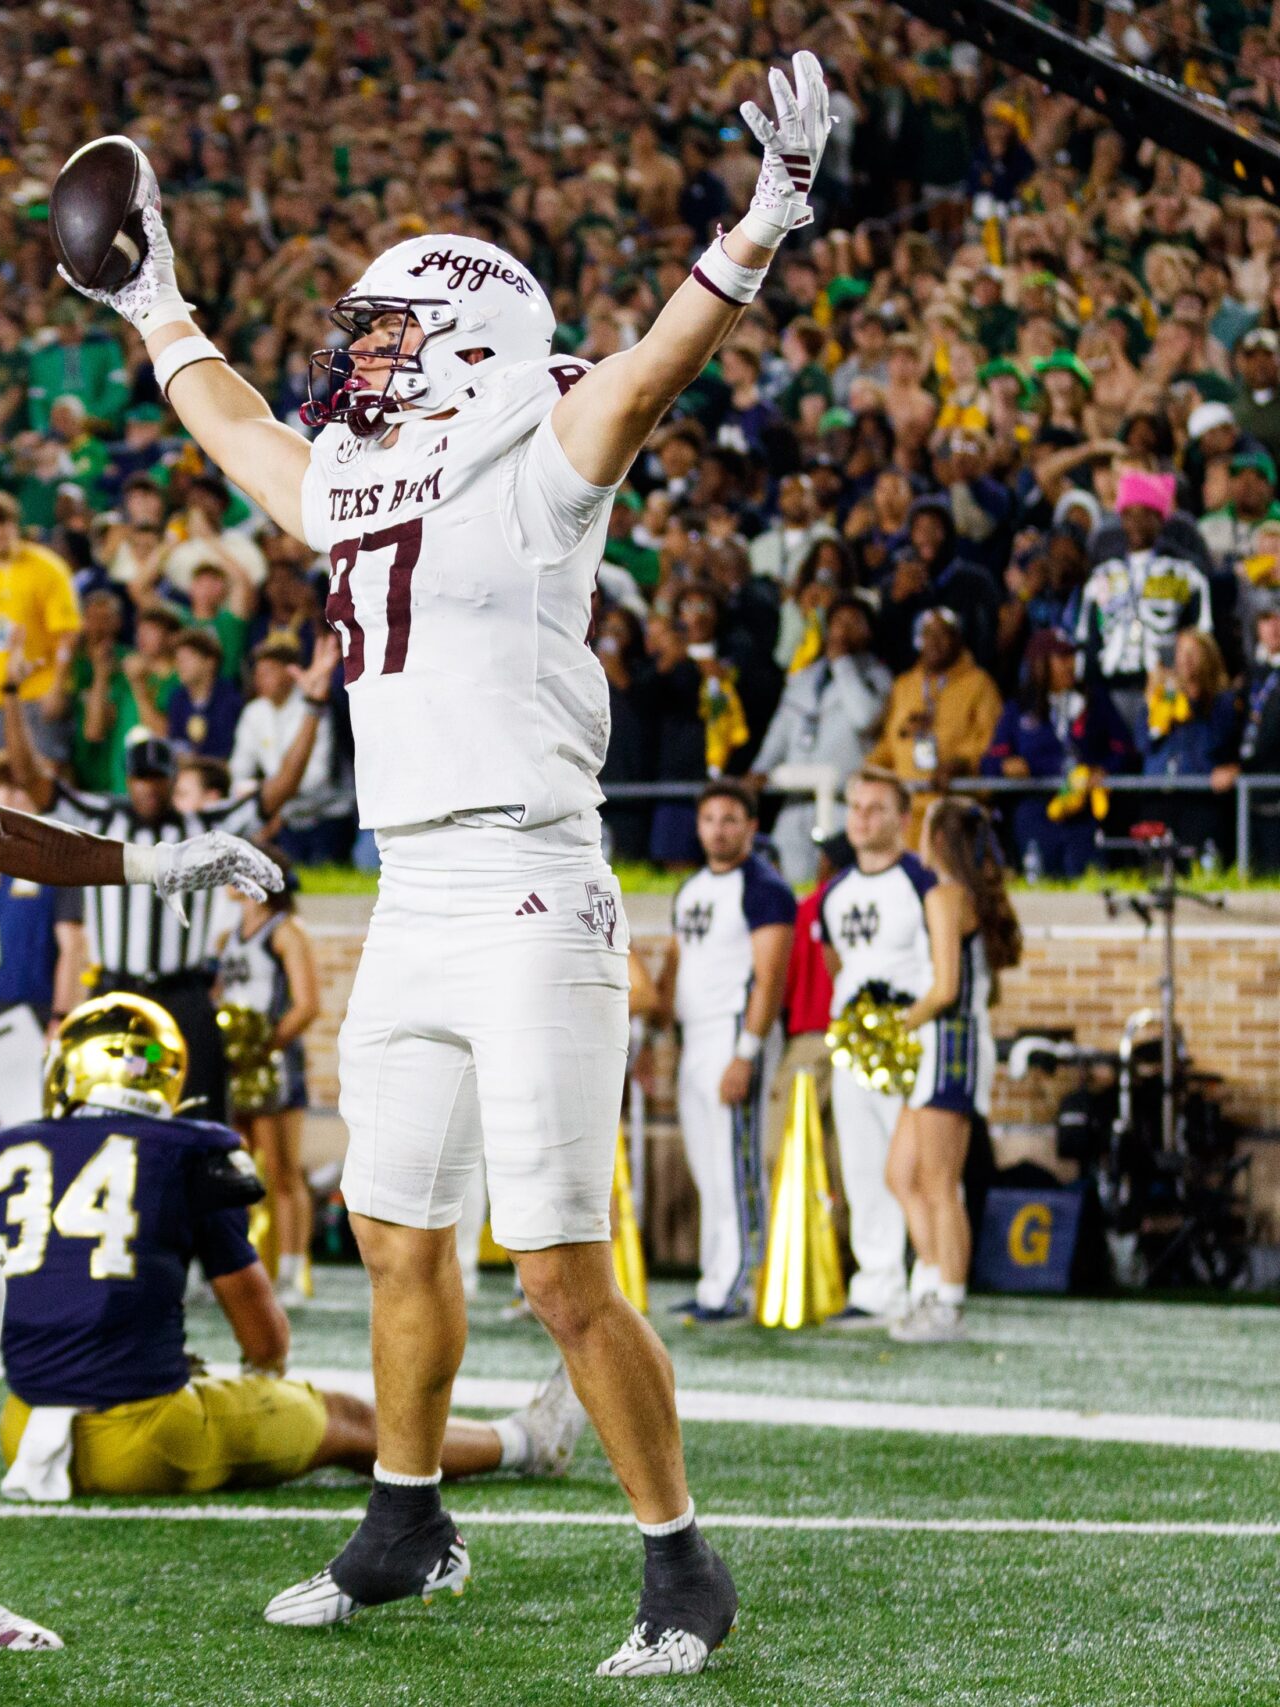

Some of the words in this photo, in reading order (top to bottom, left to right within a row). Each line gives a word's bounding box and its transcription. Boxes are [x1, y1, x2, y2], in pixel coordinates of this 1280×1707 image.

[407, 250, 534, 296] Aggies
[328, 484, 384, 521] TEXS
[388, 467, 444, 513] A&M
[325, 517, 423, 686] 87
[1007, 1203, 1054, 1267] G
